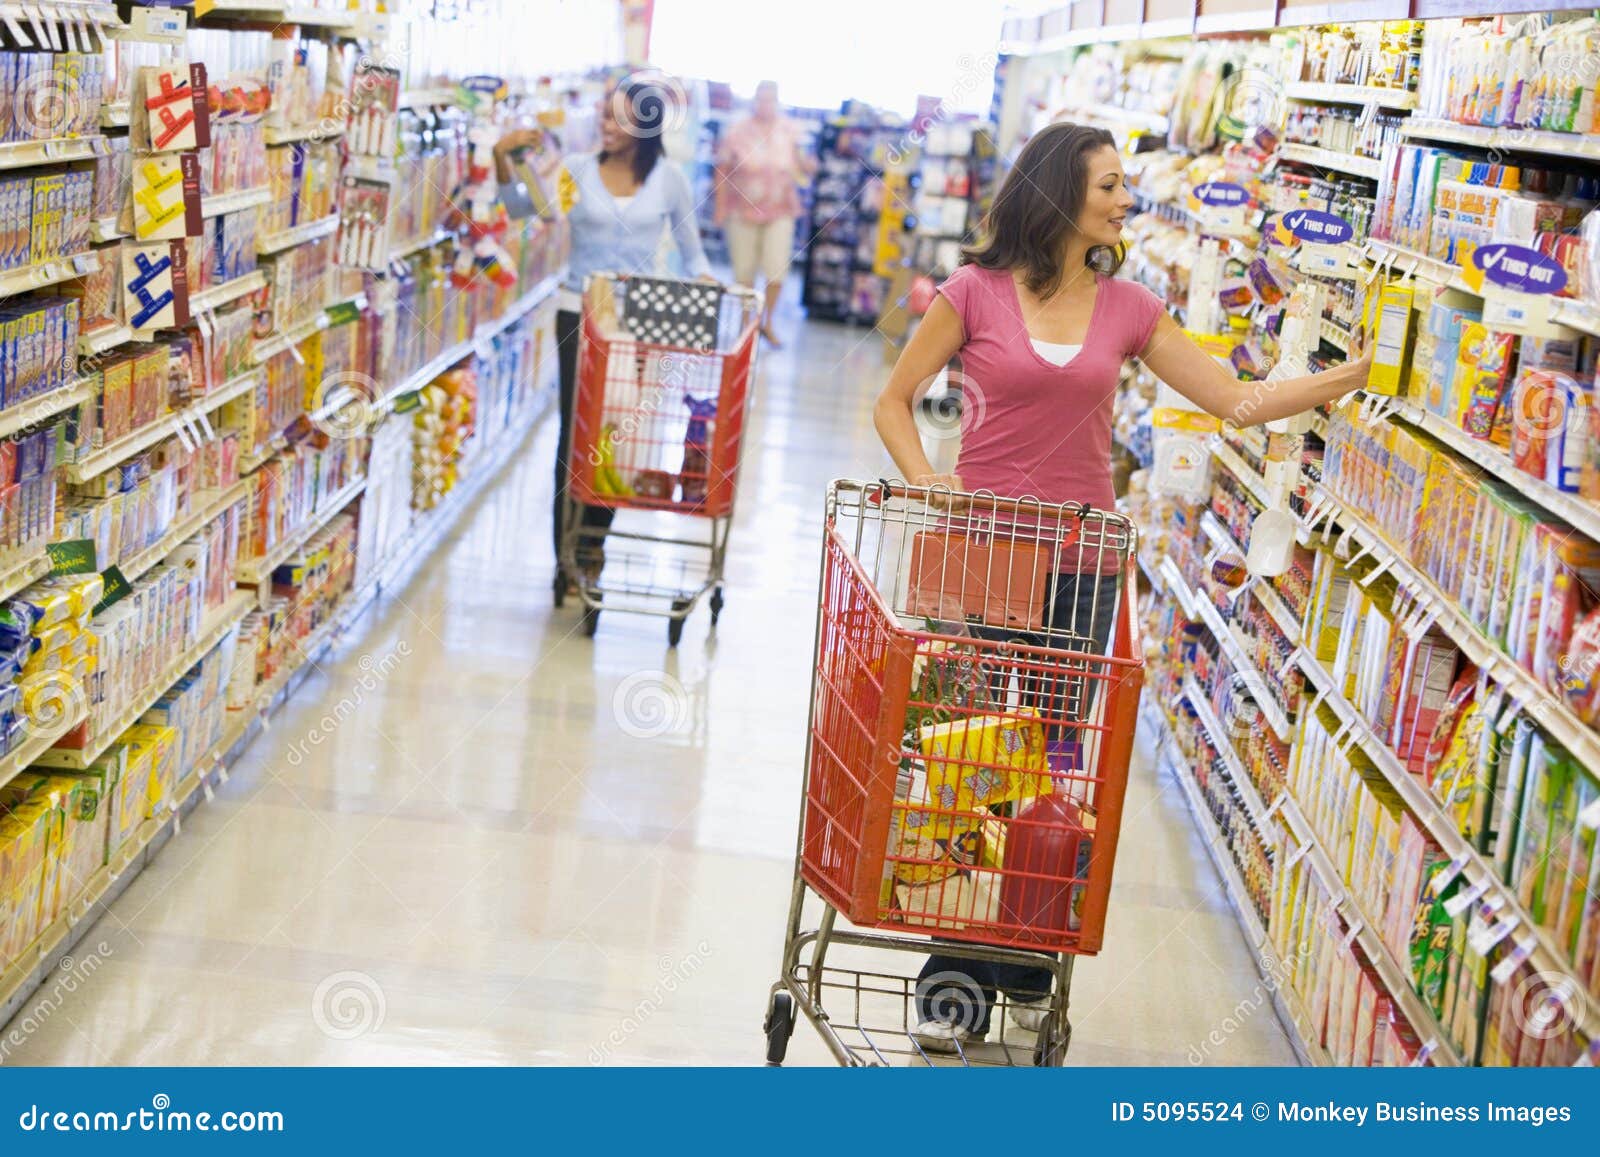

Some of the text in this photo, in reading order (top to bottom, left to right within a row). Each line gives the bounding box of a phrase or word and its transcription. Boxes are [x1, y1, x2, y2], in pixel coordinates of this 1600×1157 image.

[1304, 219, 1343, 237] THIS OUT
[1501, 257, 1555, 284] THIS OUT
